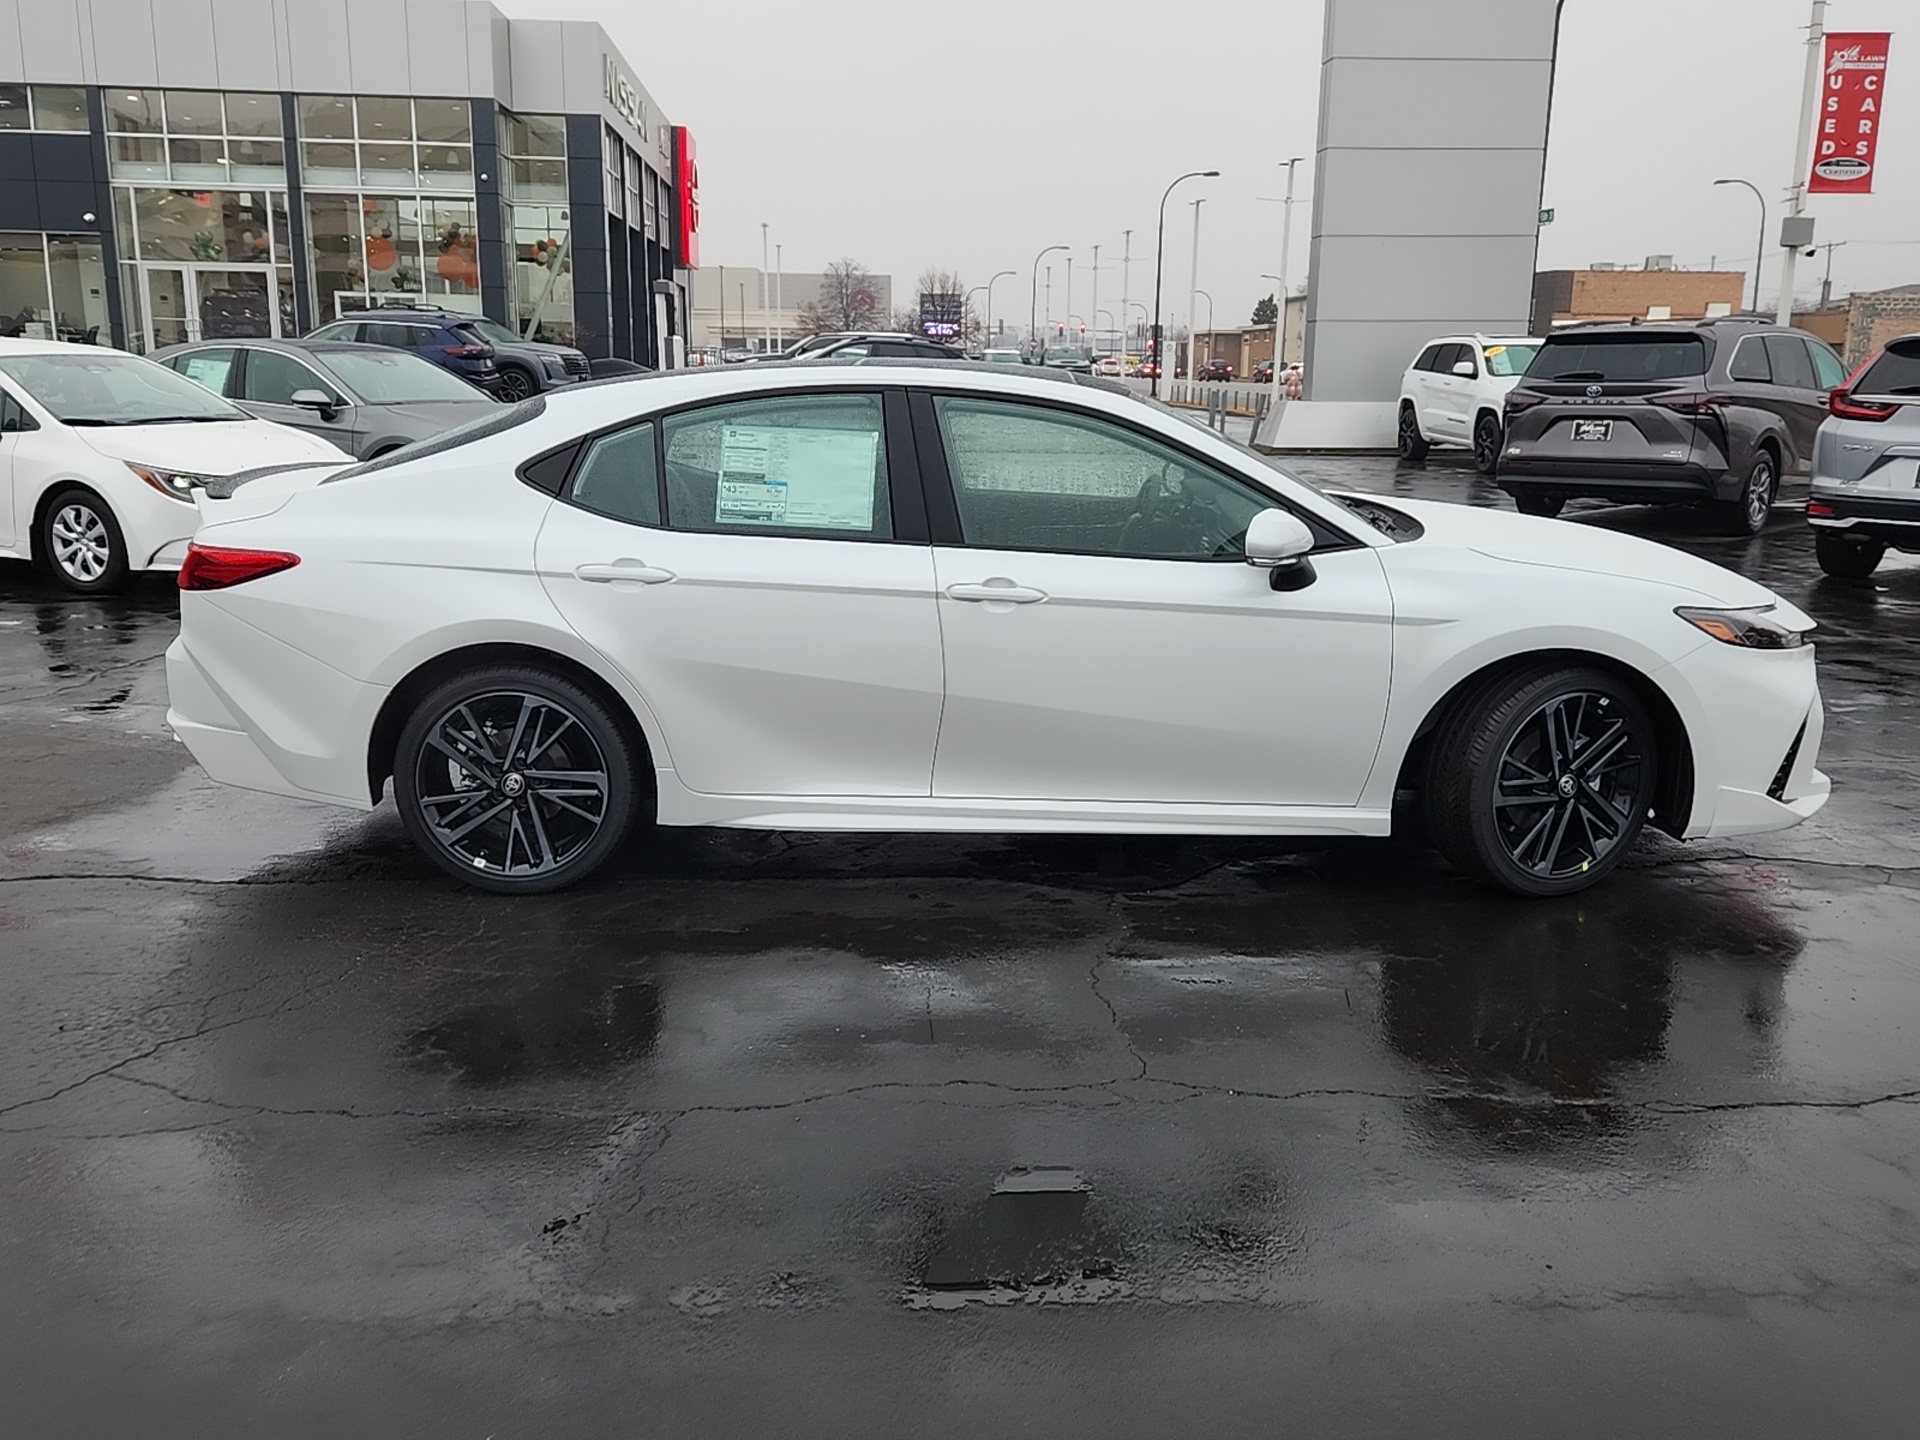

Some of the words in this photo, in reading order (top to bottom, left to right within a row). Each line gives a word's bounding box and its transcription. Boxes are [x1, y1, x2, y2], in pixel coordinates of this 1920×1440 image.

[602, 53, 648, 143] NISSAN
[1821, 75, 1843, 155] USED
[1855, 75, 1878, 155] CARS
